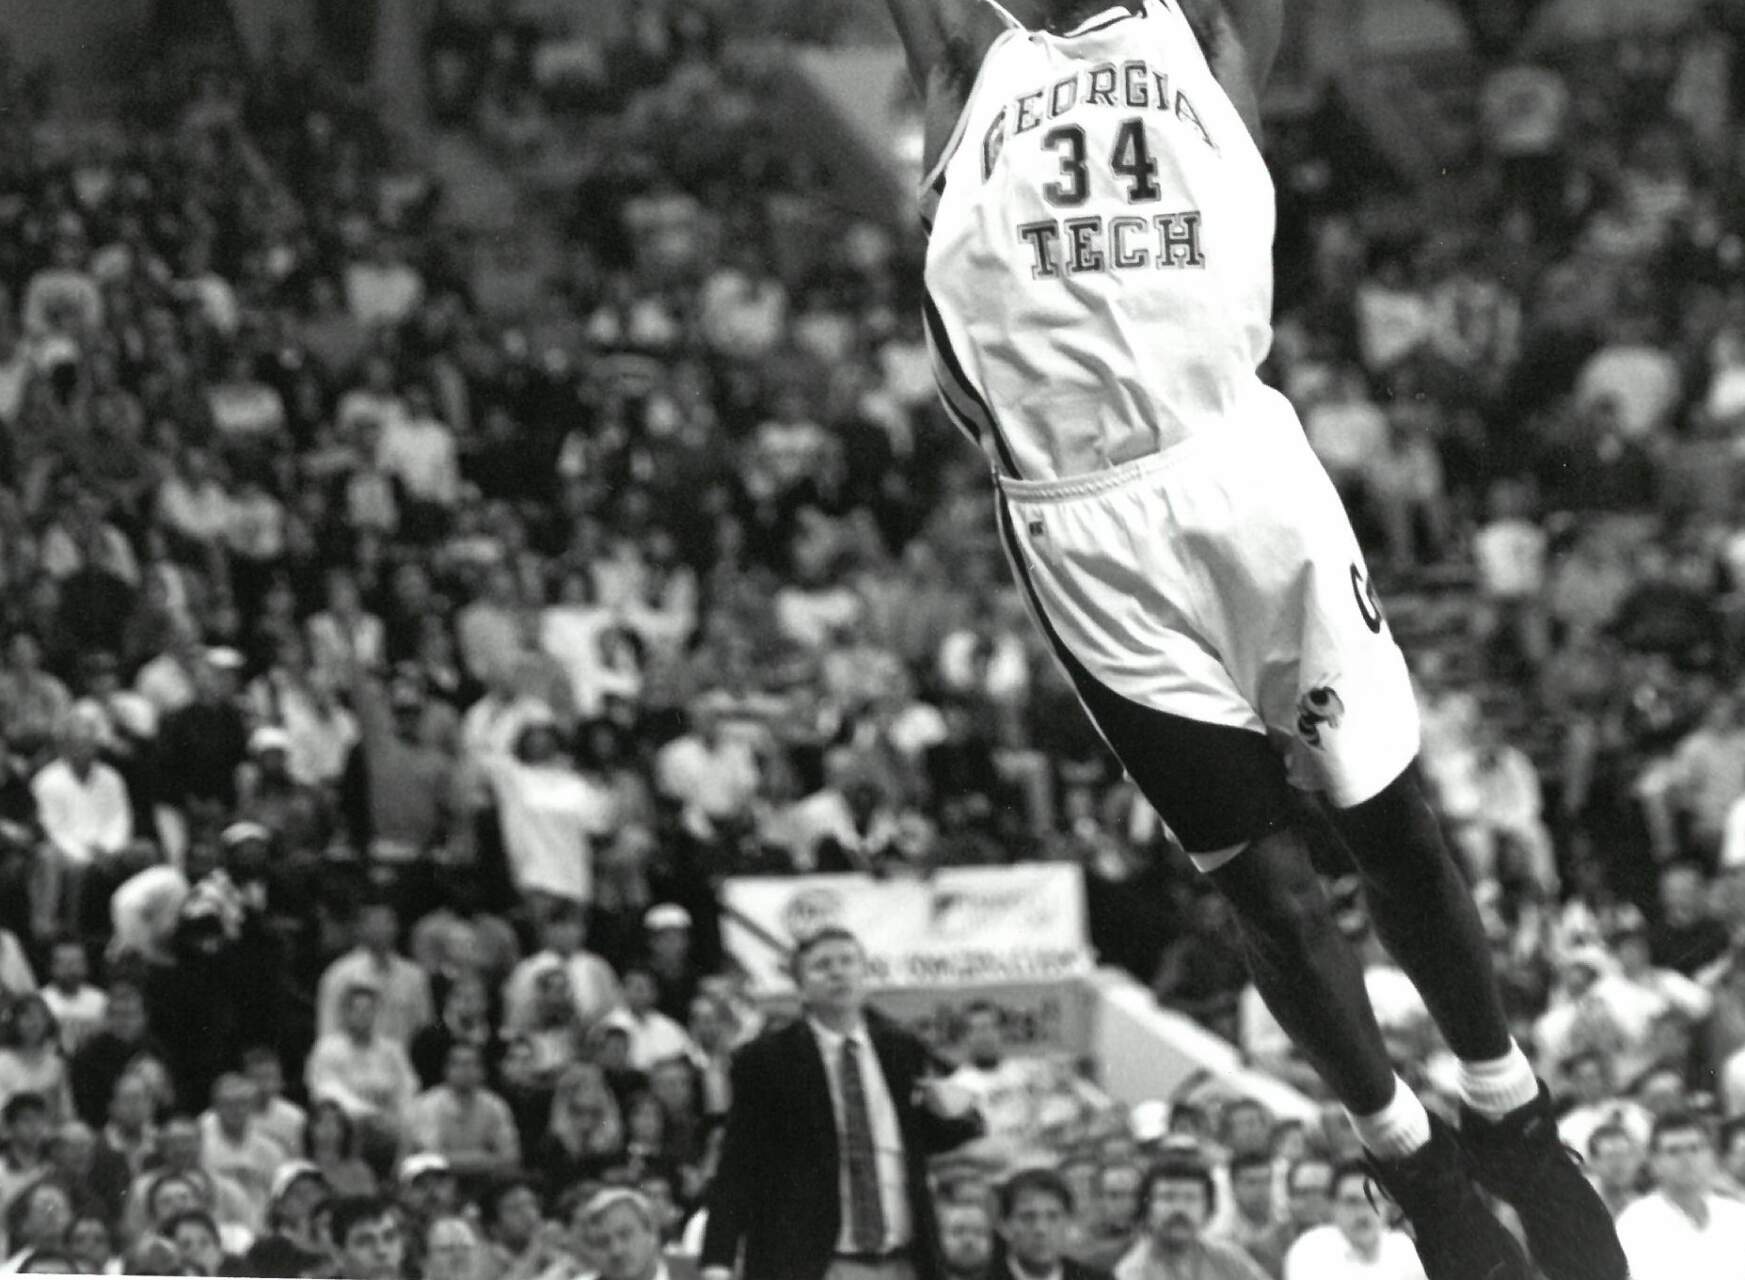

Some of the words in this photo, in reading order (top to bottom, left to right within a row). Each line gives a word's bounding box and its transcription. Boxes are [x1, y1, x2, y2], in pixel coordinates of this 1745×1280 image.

[981, 60, 1220, 183] GEORGIA
[1041, 117, 1161, 207] 34
[1017, 210, 1206, 279] TECH
